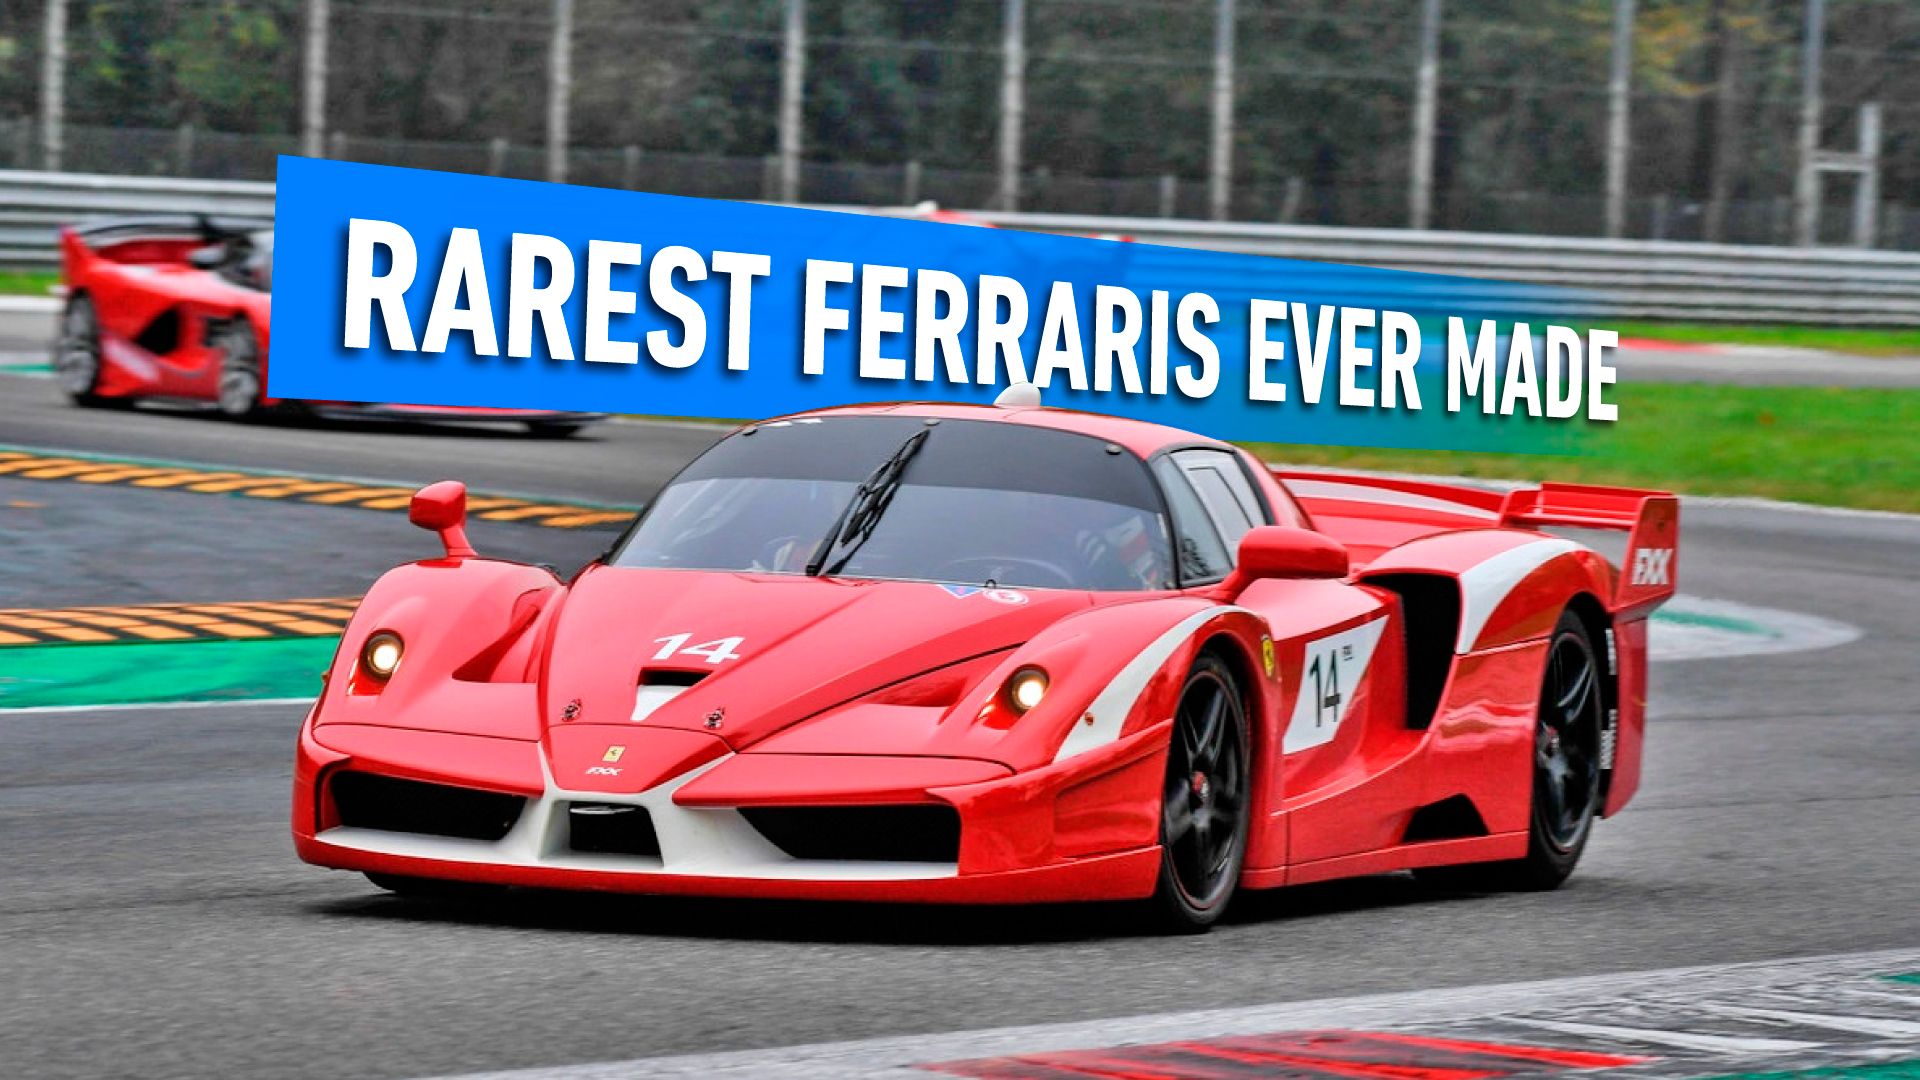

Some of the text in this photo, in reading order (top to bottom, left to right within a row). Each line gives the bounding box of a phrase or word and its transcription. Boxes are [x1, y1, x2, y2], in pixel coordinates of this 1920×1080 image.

[1631, 548, 1673, 586] FXX
[652, 632, 745, 665] 14
[1309, 648, 1342, 728] 14
[586, 766, 623, 776] FXX
